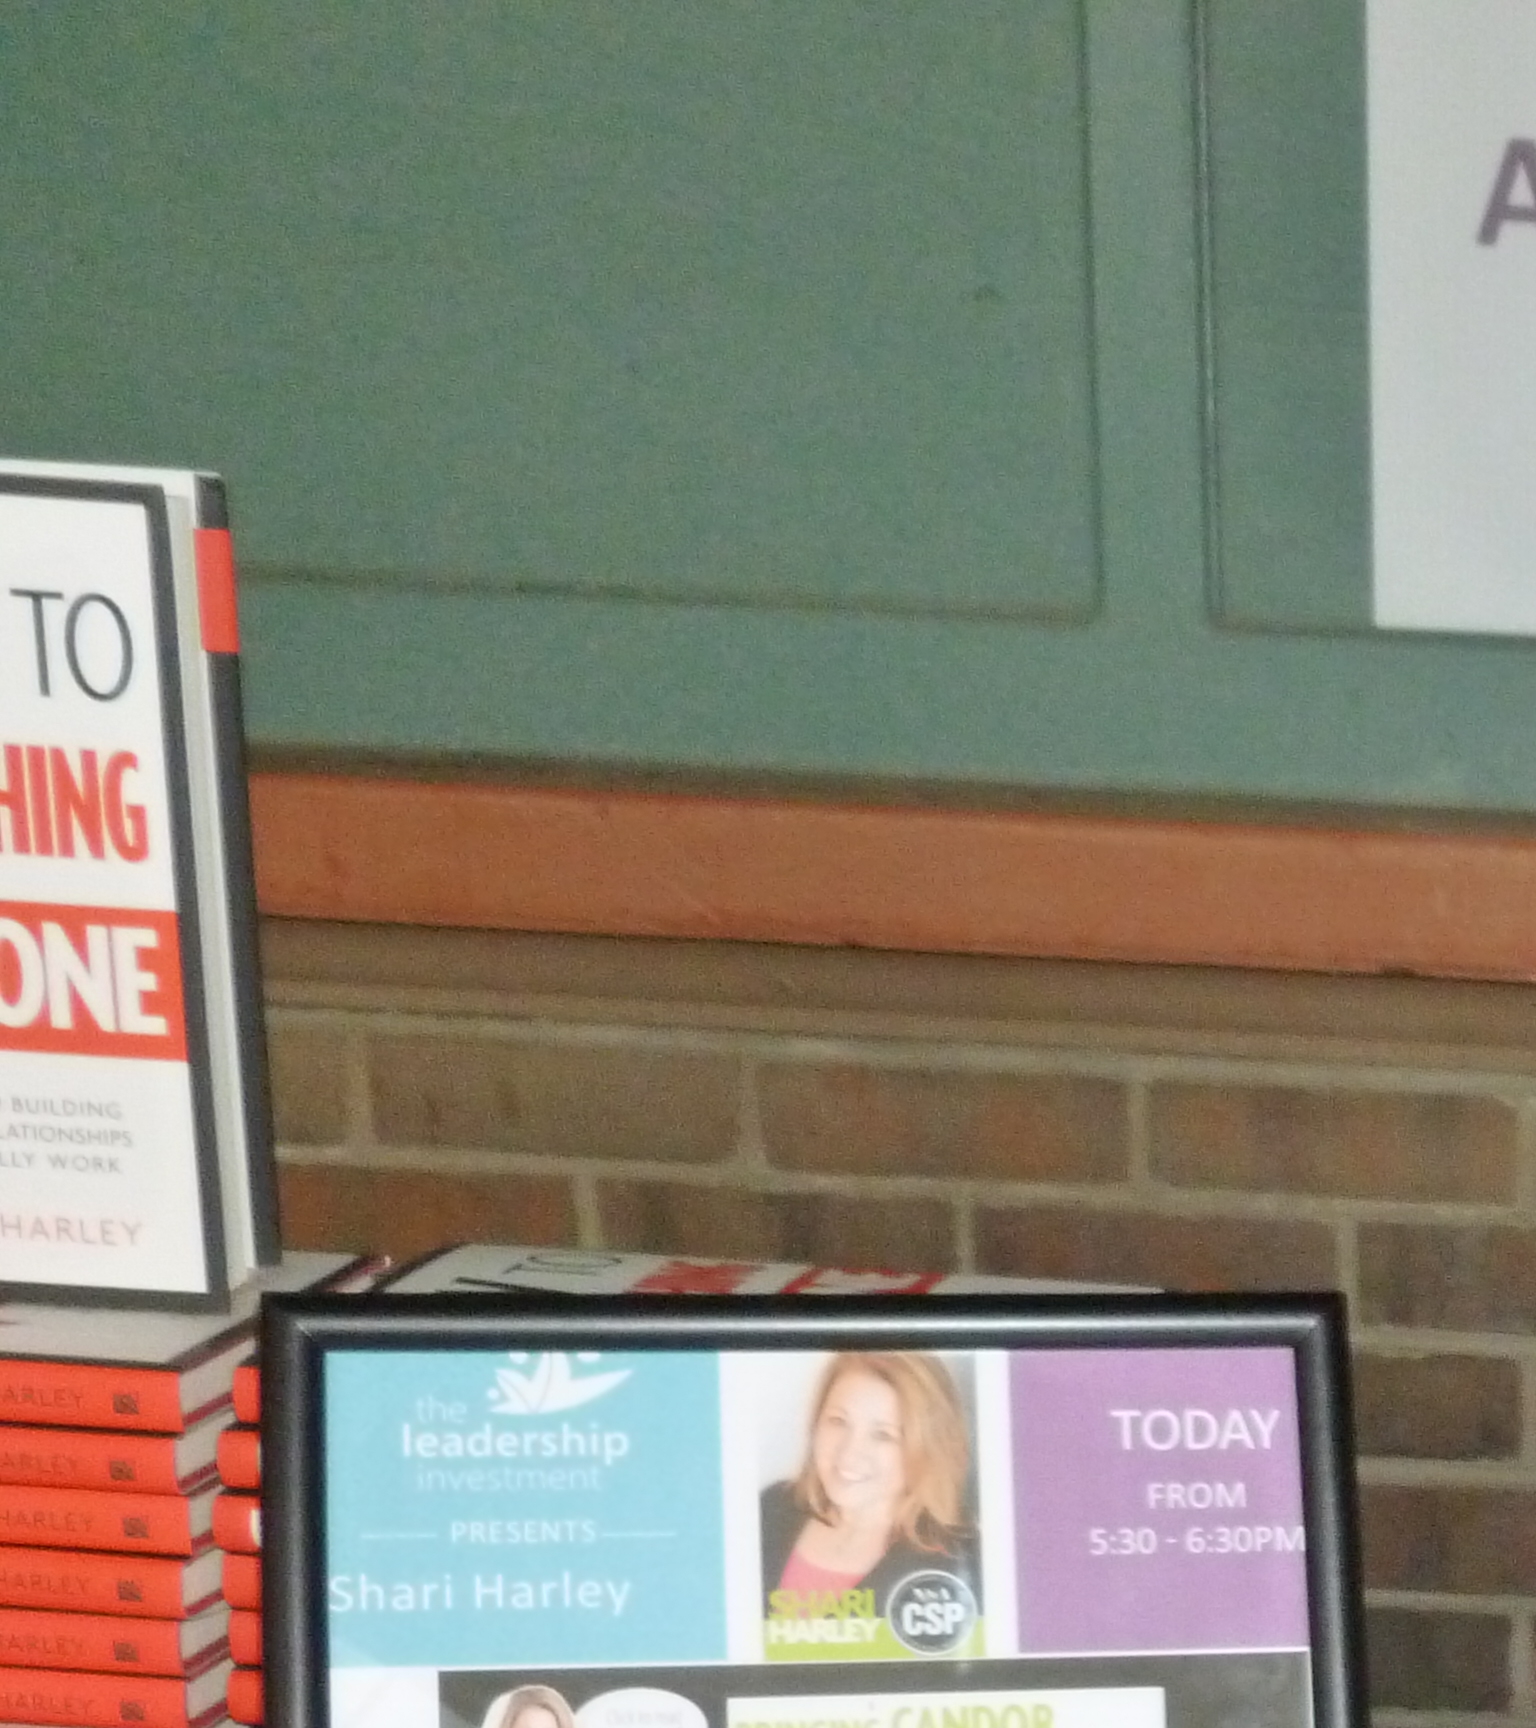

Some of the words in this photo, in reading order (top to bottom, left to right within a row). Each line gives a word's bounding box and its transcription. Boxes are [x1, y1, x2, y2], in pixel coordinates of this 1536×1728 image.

[9, 588, 134, 703] TO
[11, 1096, 123, 1120] BUILDING
[49, 1154, 122, 1174] WORK
[0, 1213, 143, 1246] HARLEY
[416, 1396, 467, 1423] the
[401, 1422, 630, 1466] leadership
[1109, 1408, 1281, 1450] TODAY
[416, 1463, 600, 1491] investment
[1147, 1481, 1247, 1509] FROM
[450, 1521, 596, 1543] PRESENTS
[1088, 1528, 1158, 1555] 5:30
[1185, 1525, 1305, 1554] 6:30PM
[329, 1574, 451, 1611] Shari
[474, 1571, 632, 1617] Harley
[768, 1588, 875, 1620] SHARI
[768, 1619, 880, 1643] HARLEY
[903, 1602, 964, 1635] CSP
